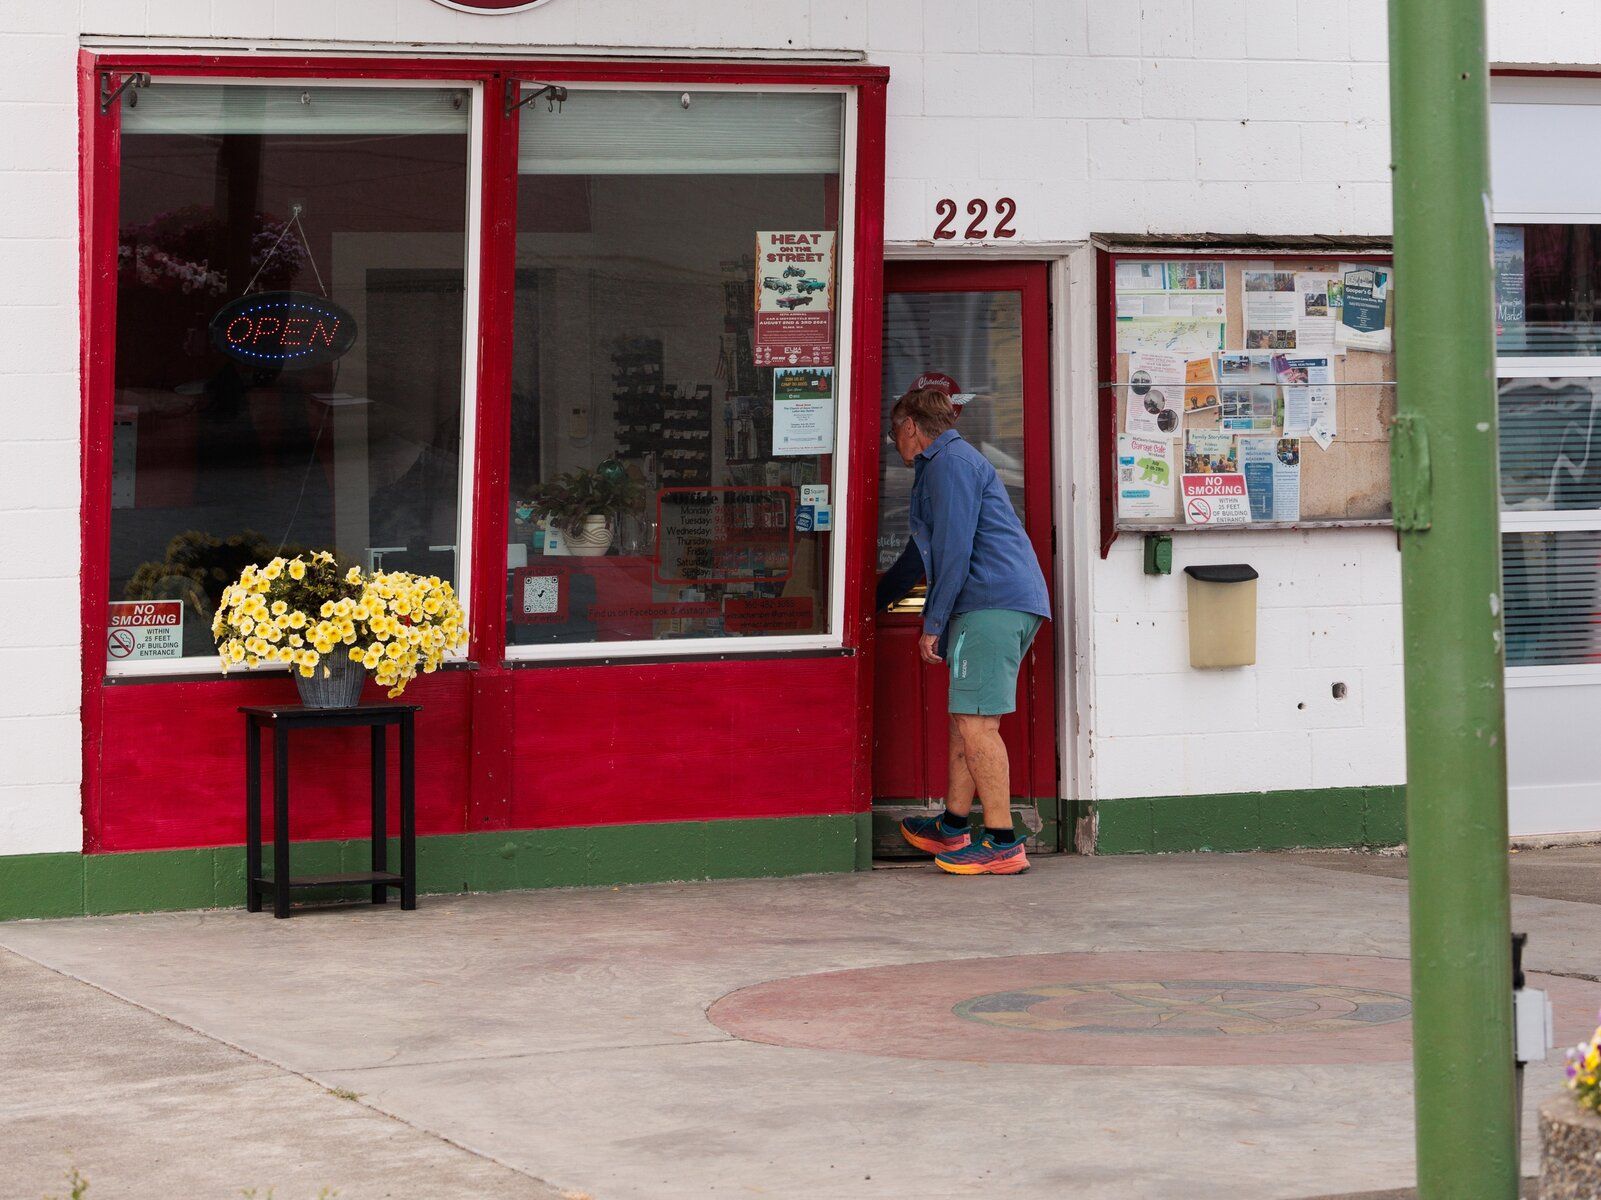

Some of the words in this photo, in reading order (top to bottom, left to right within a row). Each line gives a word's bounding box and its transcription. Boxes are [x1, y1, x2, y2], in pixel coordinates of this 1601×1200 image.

[933, 197, 1016, 240] 222
[771, 234, 821, 245] HEAT
[767, 253, 825, 263] STREET
[226, 316, 340, 347] OPEN
[918, 377, 950, 389] Chamber
[1205, 477, 1222, 486] NO
[1188, 485, 1242, 495] SMOKING
[134, 604, 155, 615] NO
[629, 607, 668, 616] Facebook
[111, 614, 176, 626] SMOKING
